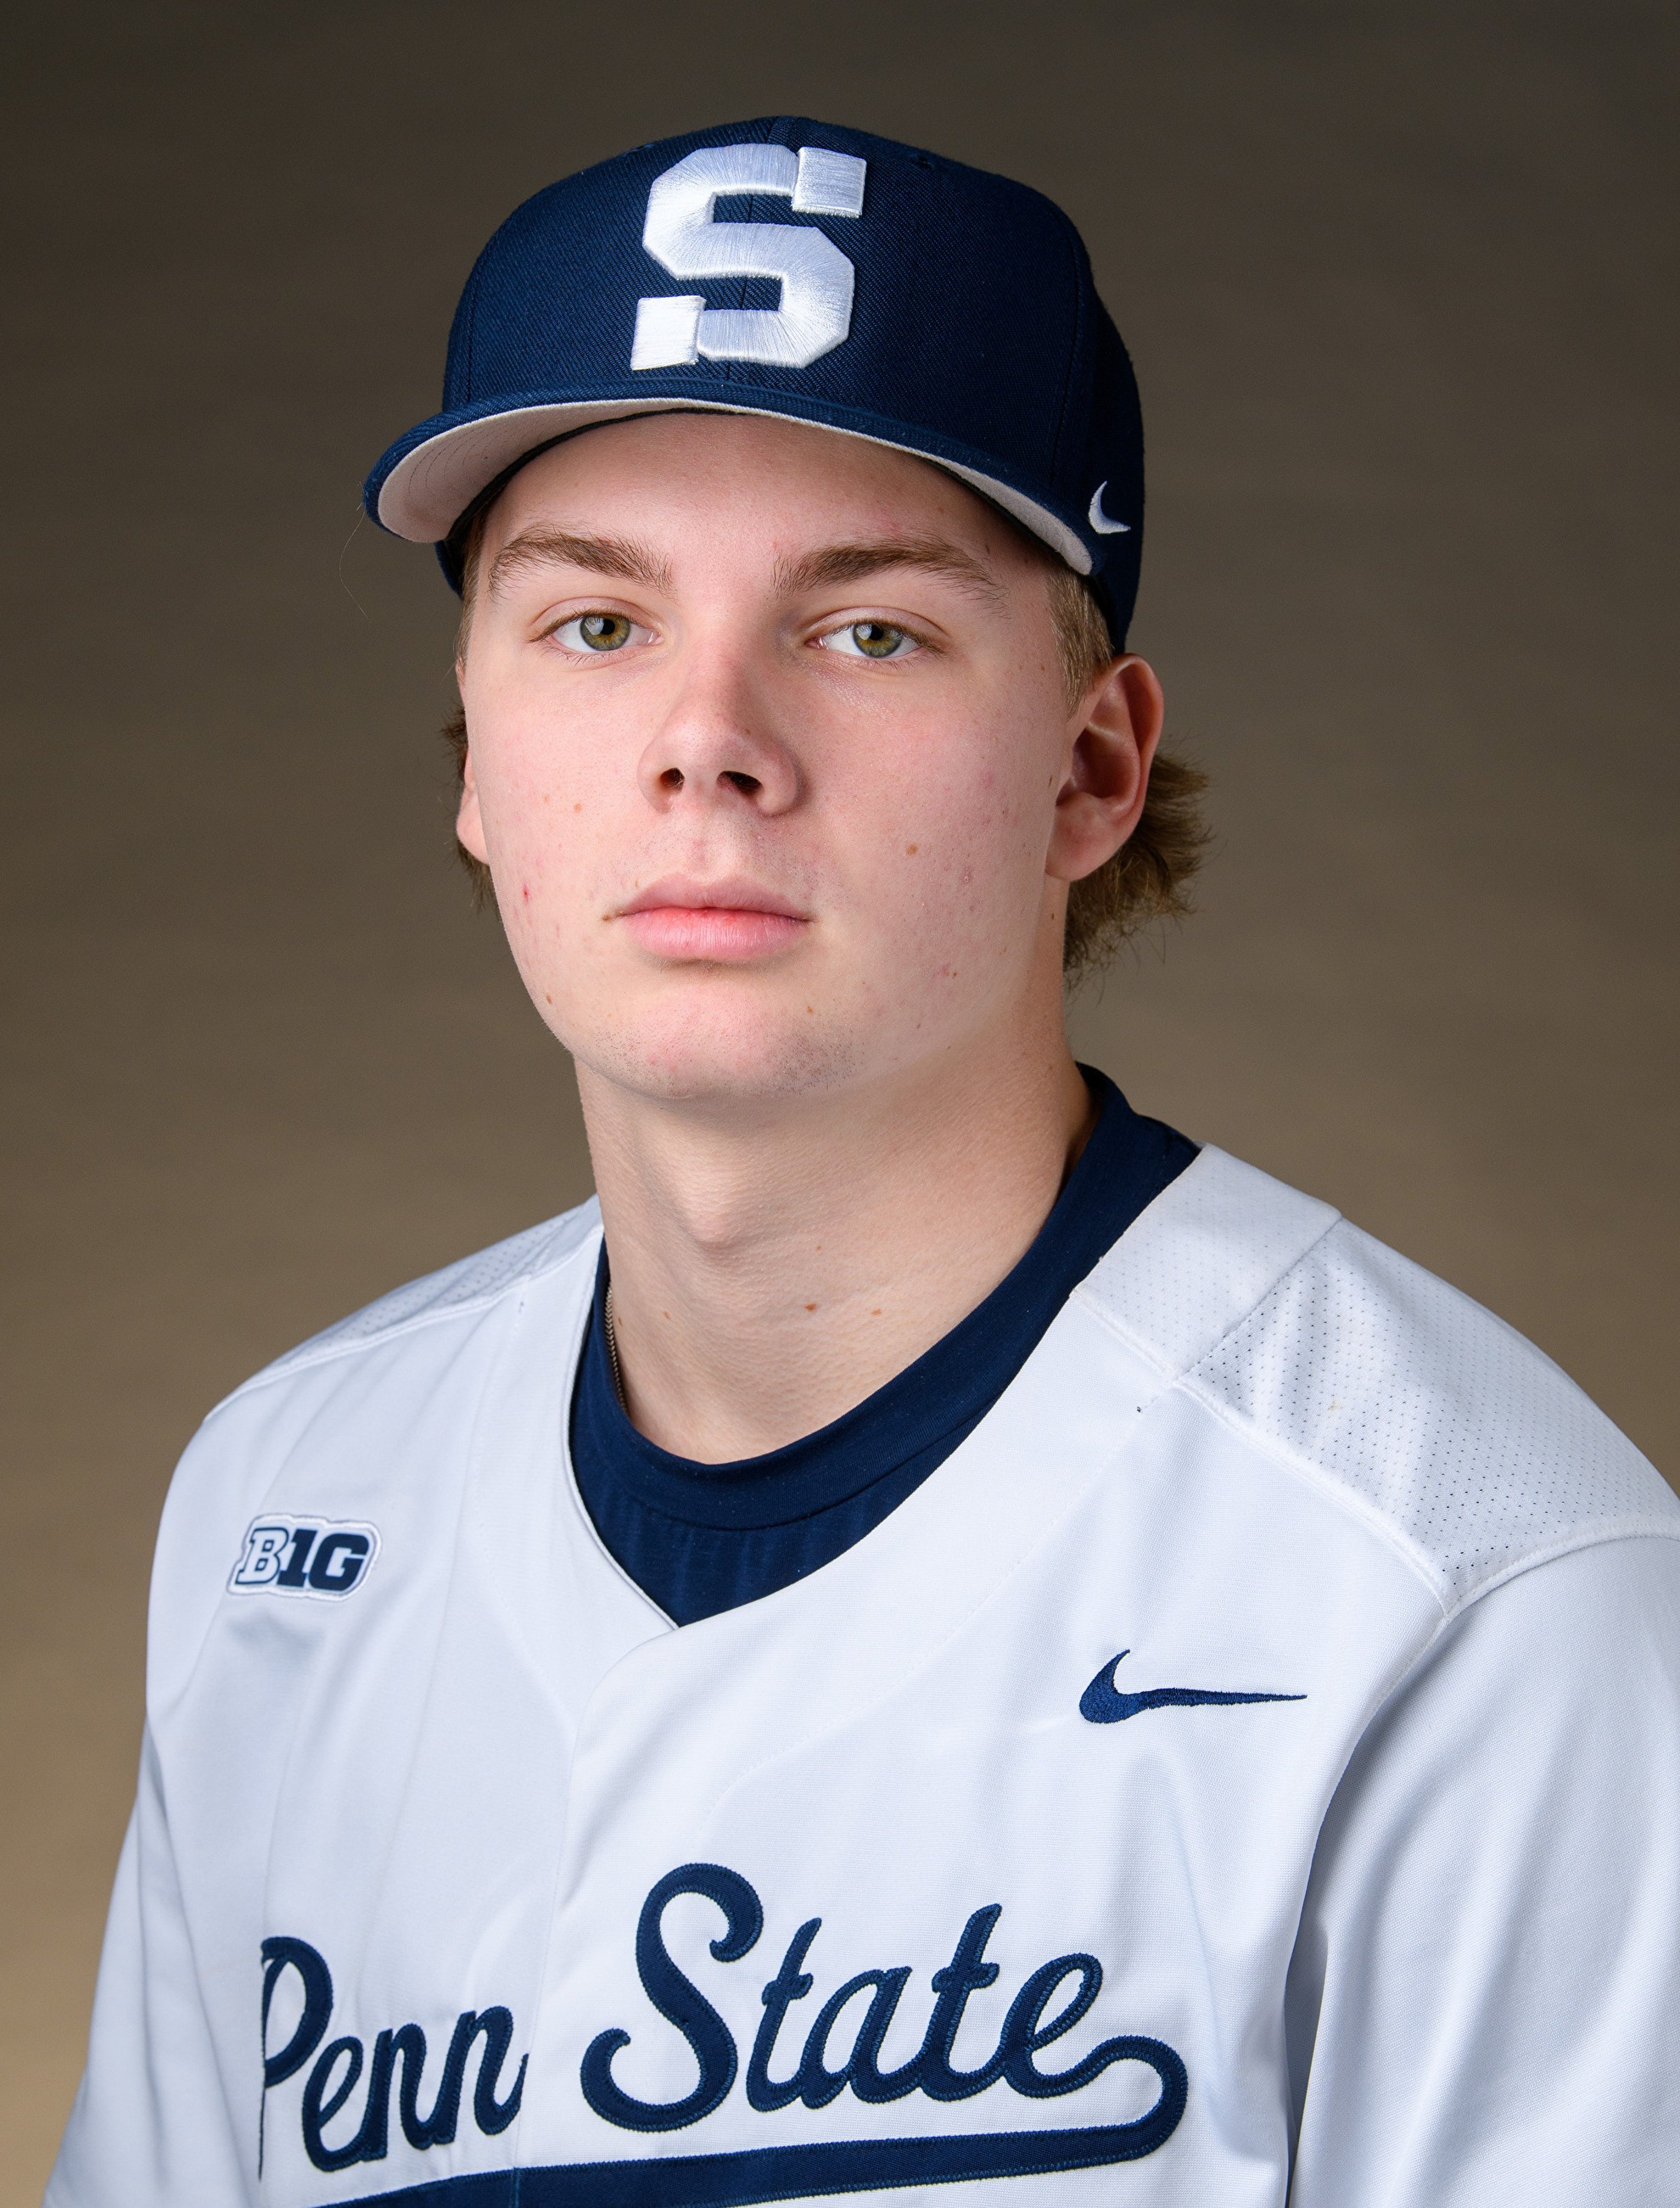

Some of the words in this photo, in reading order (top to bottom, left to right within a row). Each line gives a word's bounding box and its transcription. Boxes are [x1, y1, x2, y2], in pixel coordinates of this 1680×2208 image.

[630, 143, 867, 371] S
[258, 1936, 528, 2181] Penn
[580, 1862, 1188, 2132] State
